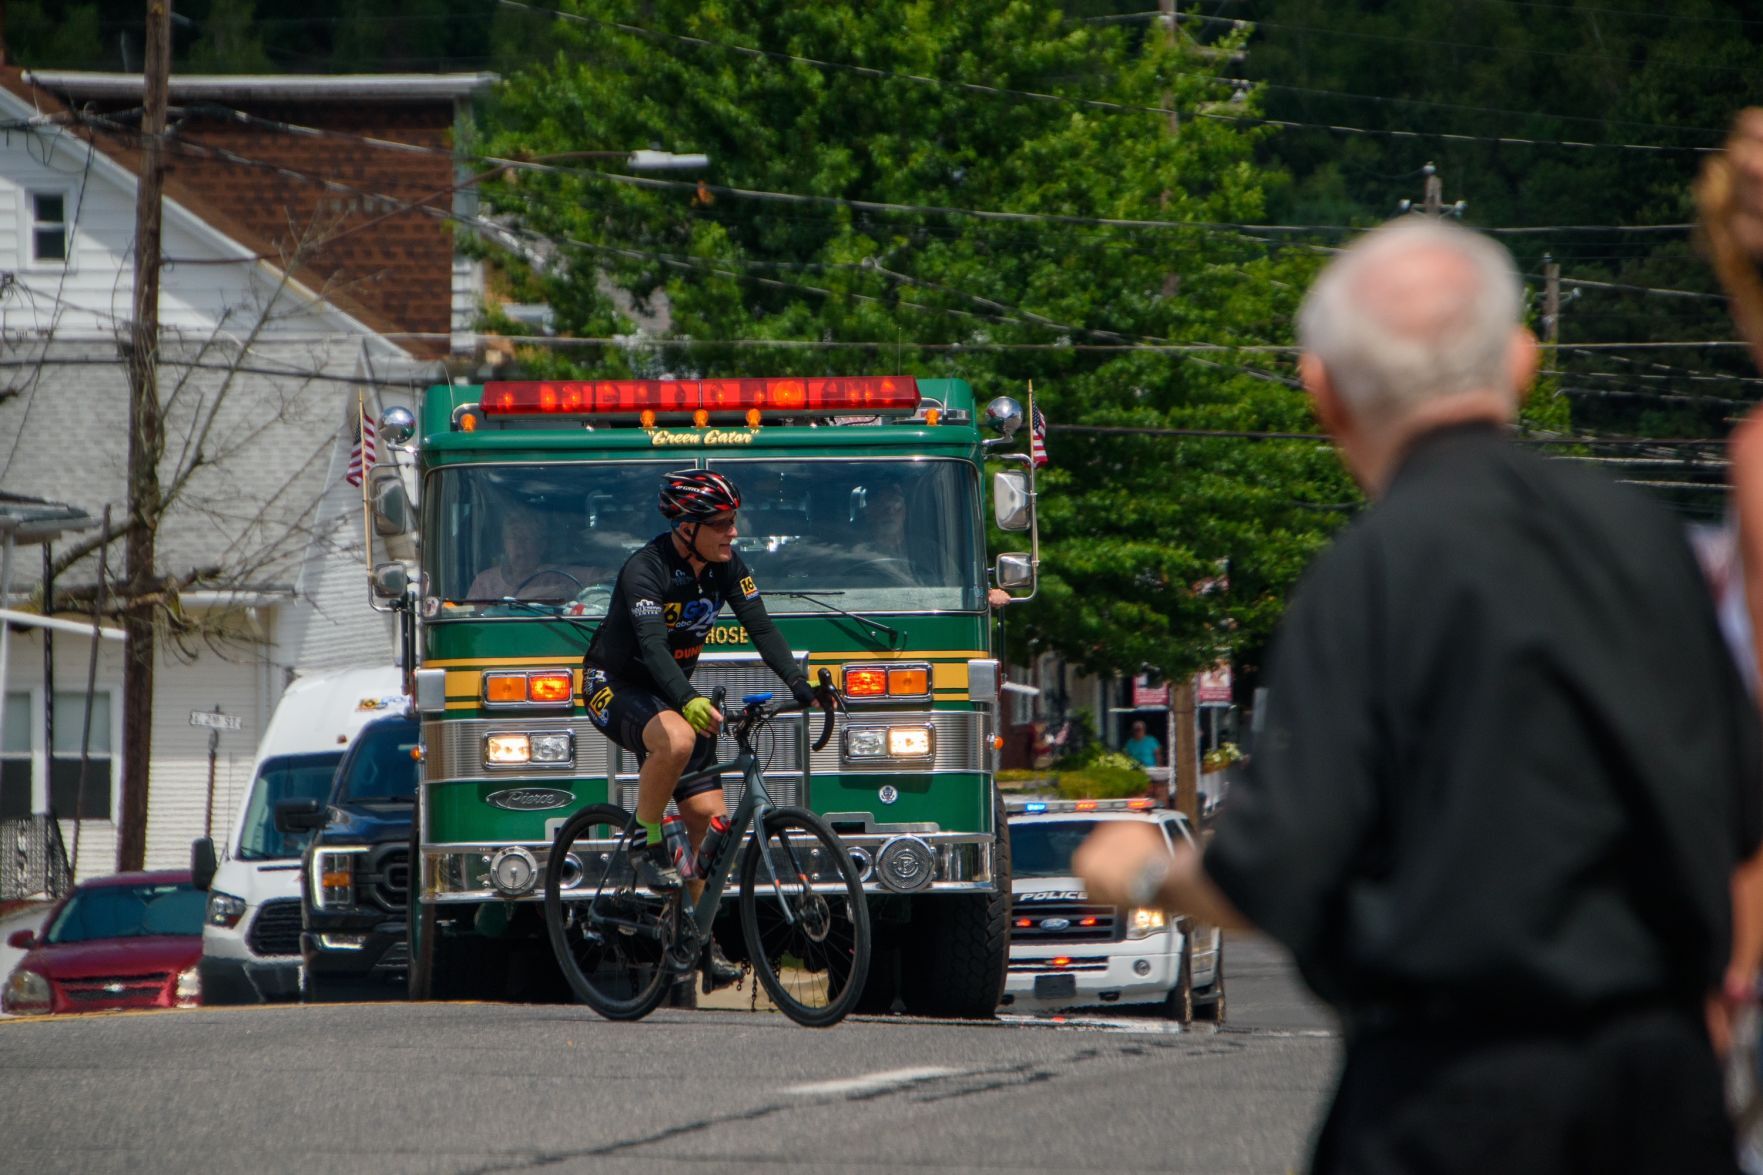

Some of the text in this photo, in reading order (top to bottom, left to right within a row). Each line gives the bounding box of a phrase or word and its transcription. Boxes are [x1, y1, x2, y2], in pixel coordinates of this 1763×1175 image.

[741, 577, 755, 592] 16
[705, 626, 749, 644] HOSE
[591, 687, 612, 712] 16
[506, 791, 556, 807] Pierce
[1020, 891, 1088, 901] POLICE
